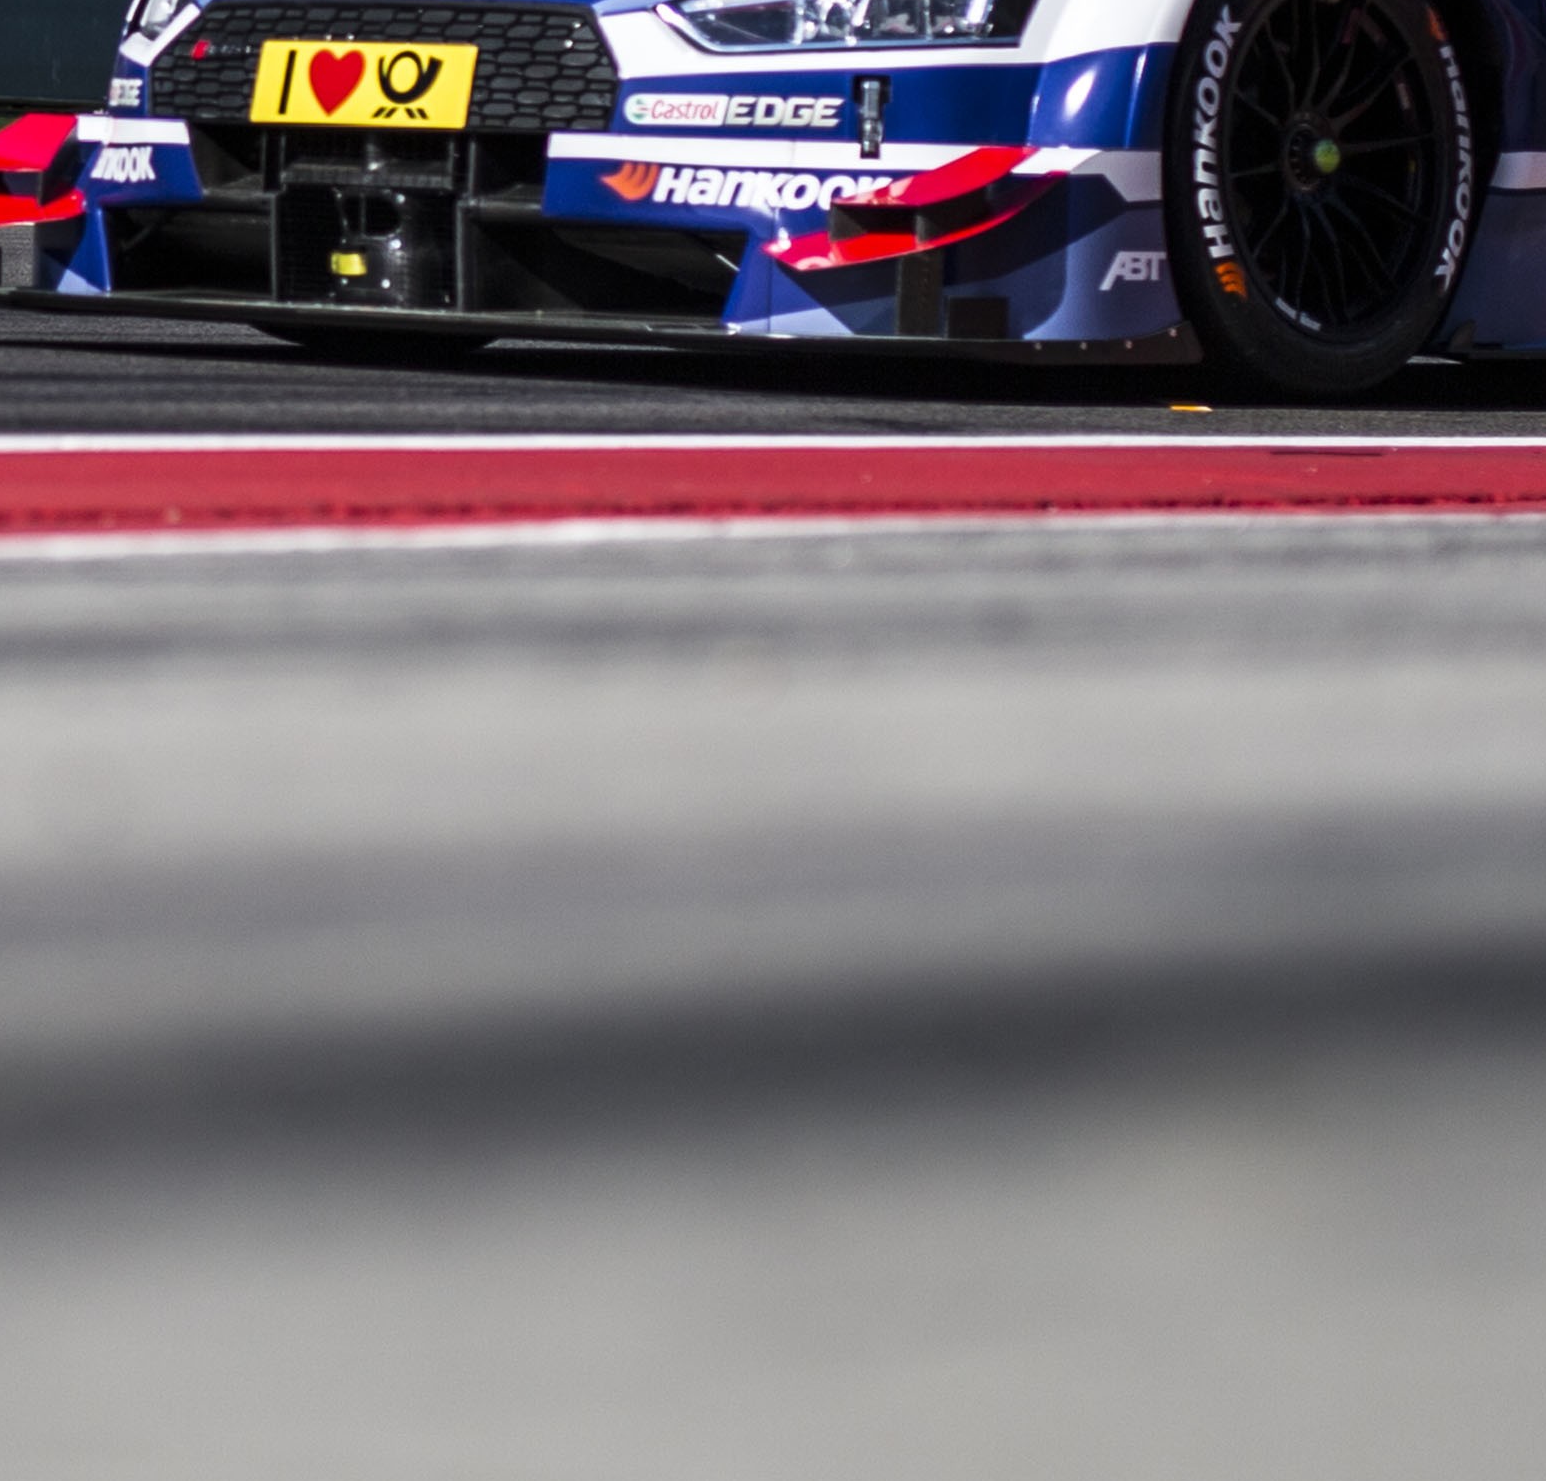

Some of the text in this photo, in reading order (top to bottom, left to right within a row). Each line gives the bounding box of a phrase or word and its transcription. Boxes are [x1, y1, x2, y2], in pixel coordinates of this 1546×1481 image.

[278, 49, 297, 115] I
[650, 96, 845, 128] Castrol EDGE
[1099, 251, 1167, 291] ABT
